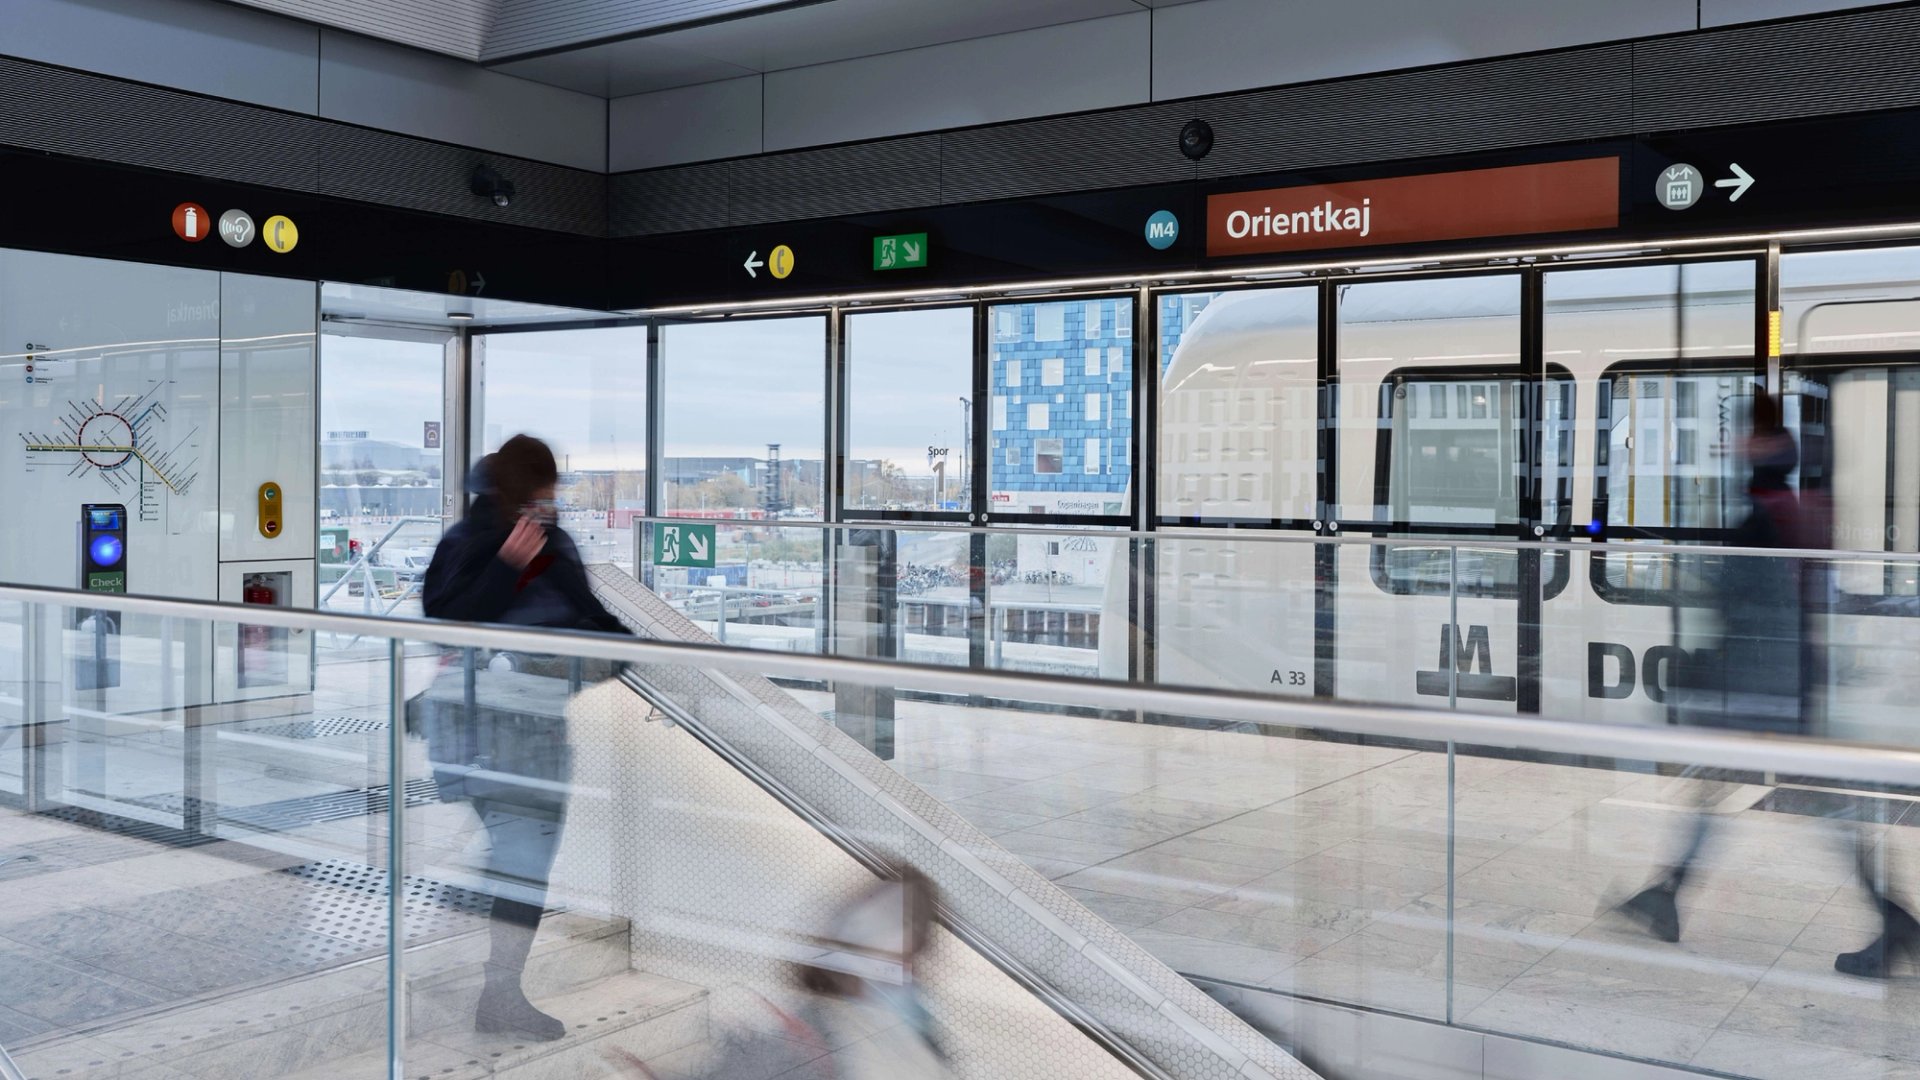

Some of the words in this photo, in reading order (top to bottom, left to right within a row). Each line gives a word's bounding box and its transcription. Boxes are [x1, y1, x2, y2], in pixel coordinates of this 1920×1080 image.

[1226, 197, 1370, 239] Orientkaj
[1149, 221, 1175, 239] M4
[927, 445, 949, 458] Spor
[932, 461, 944, 492] 1
[90, 577, 122, 588] Check
[1270, 669, 1283, 684] A
[1289, 670, 1306, 686] 33
[1587, 641, 1720, 705] DO
